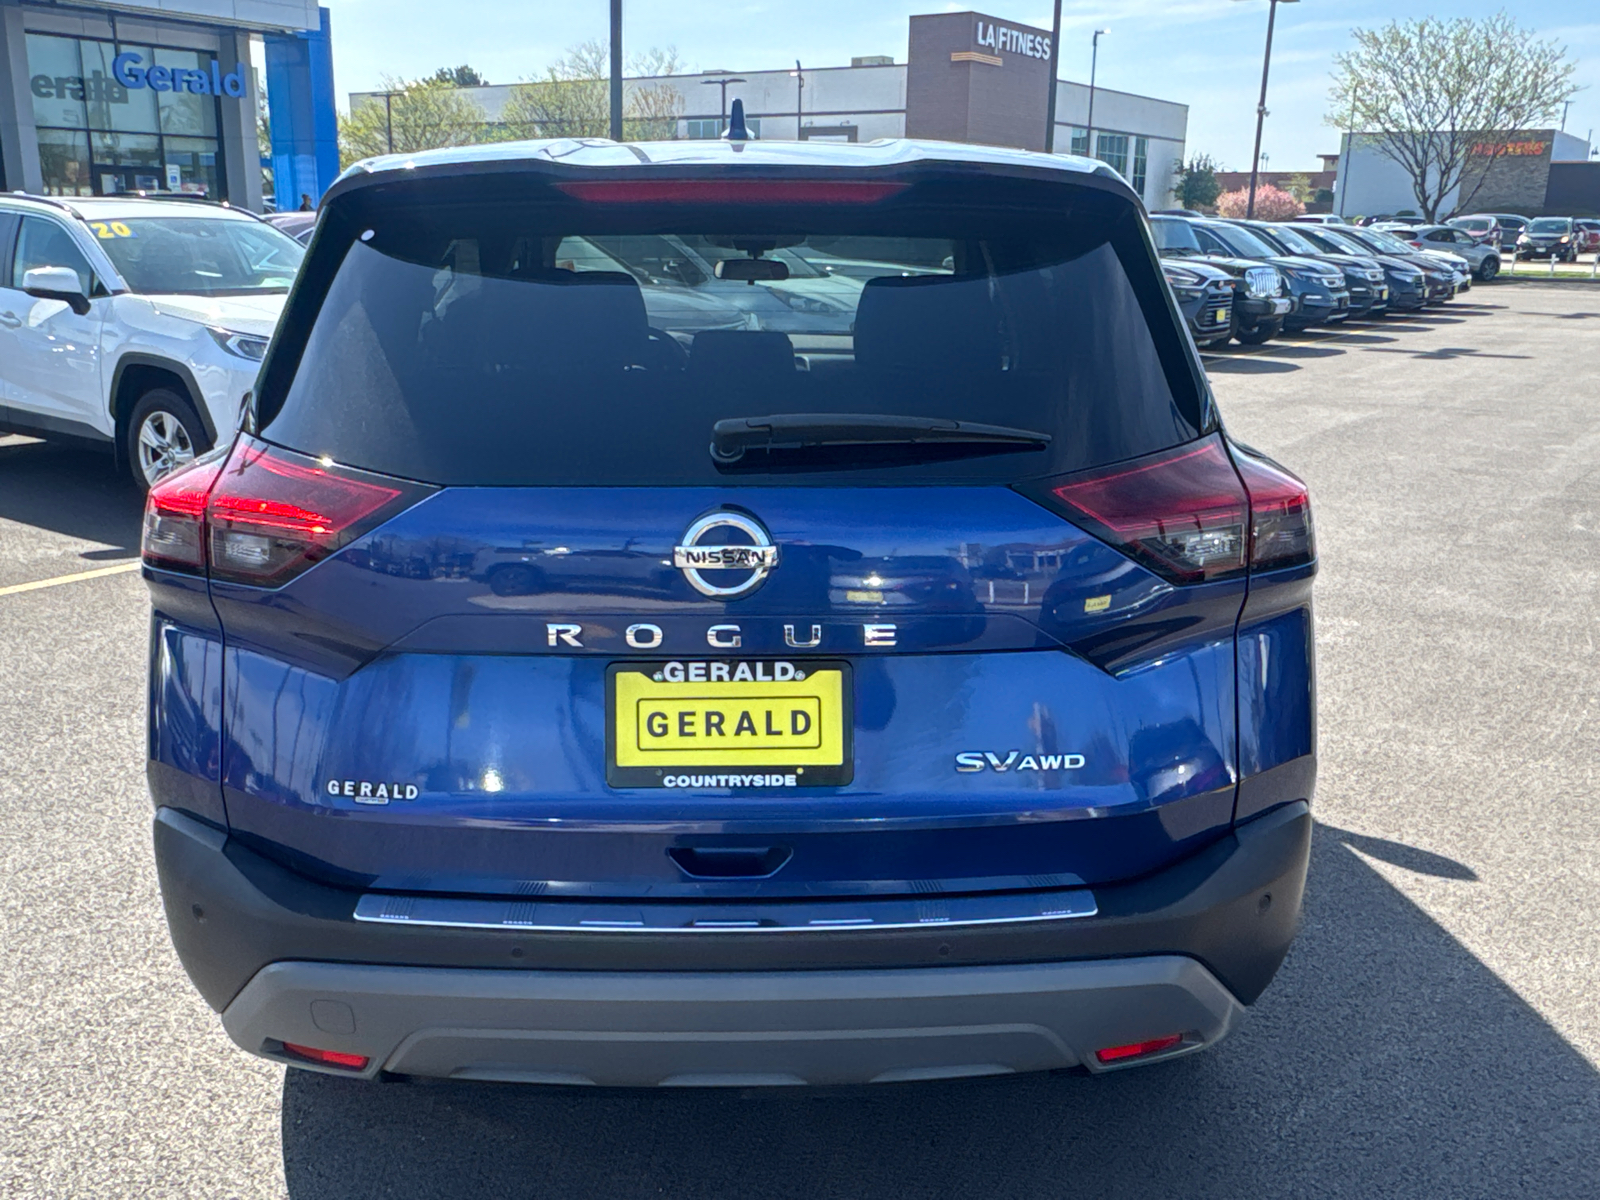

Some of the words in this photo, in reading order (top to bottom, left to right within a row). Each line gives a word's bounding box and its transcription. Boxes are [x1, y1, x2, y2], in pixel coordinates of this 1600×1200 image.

[977, 21, 995, 48] LA
[998, 27, 1051, 61] FITNESS
[112, 52, 247, 98] Gerald
[90, 221, 132, 239] 20
[685, 550, 767, 565] NISSAN
[546, 623, 898, 648] ROGUE
[663, 661, 796, 682] GERALD
[646, 710, 812, 738] GERALD
[955, 750, 1020, 773] SV
[1017, 754, 1086, 771] AWD
[327, 779, 419, 800] GERALD
[663, 773, 797, 788] COUNTRYSIDE
